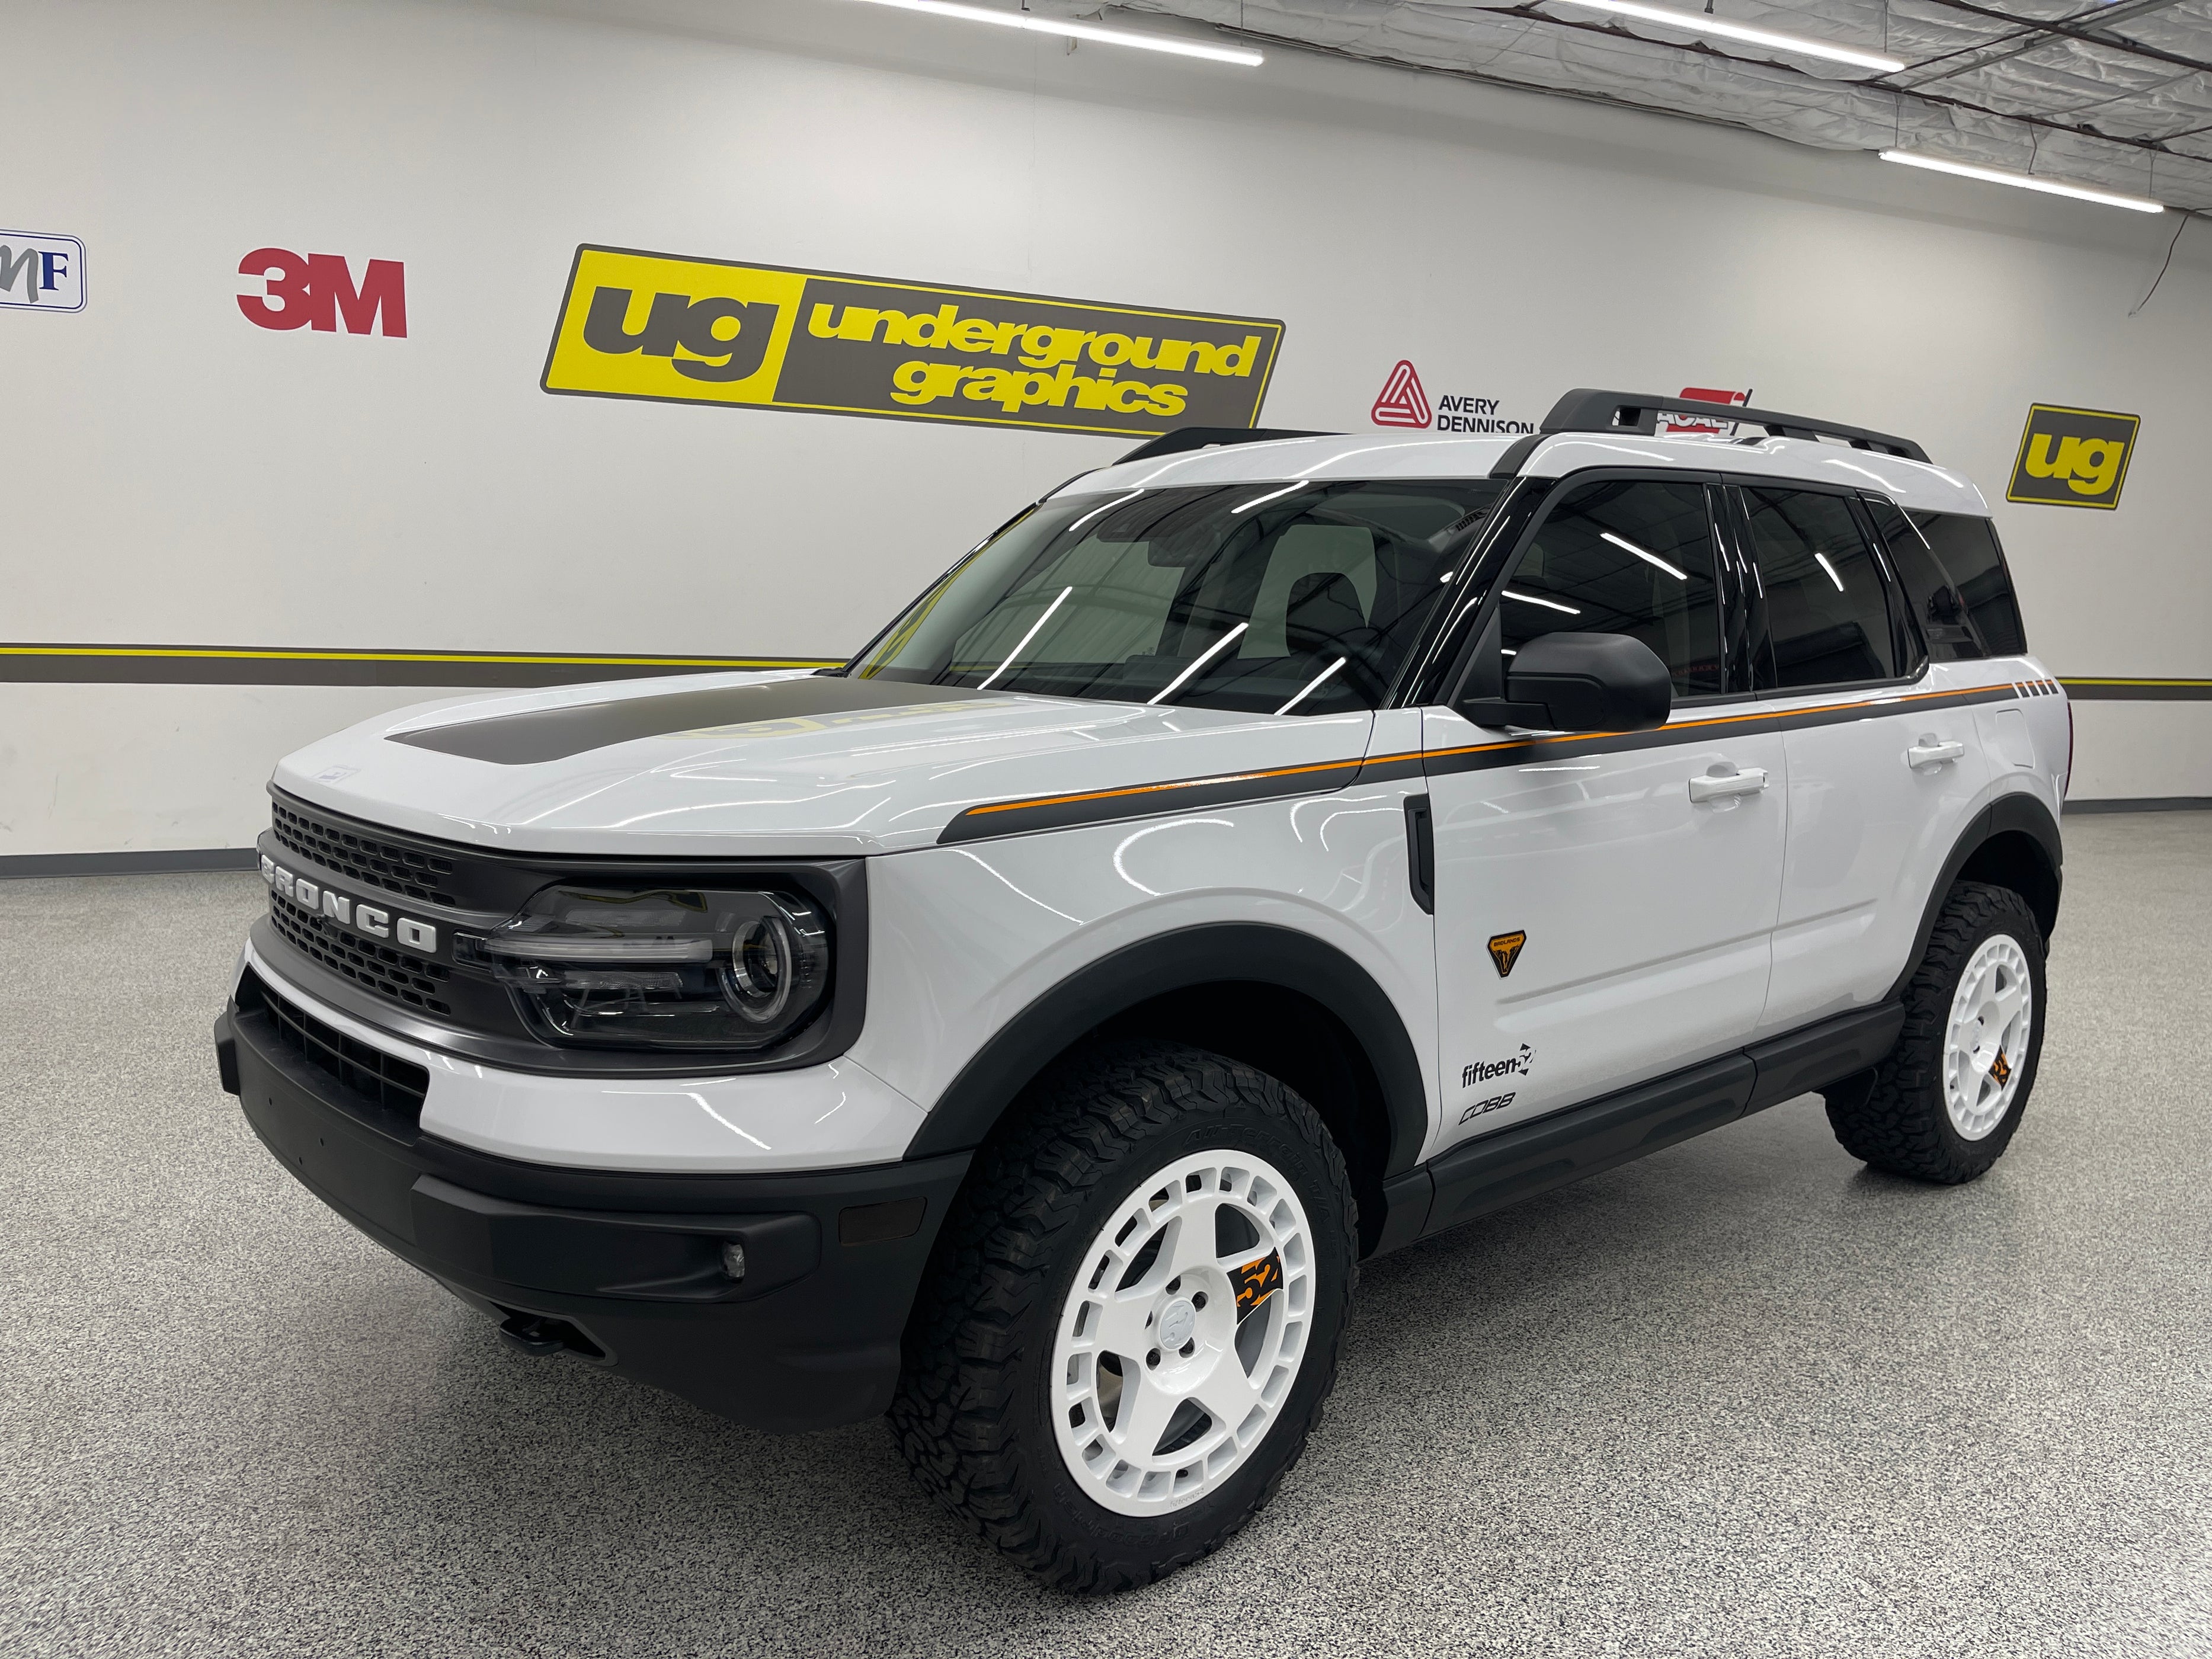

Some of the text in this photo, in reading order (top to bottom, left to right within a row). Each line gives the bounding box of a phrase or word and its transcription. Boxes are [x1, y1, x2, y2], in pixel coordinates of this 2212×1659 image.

[236, 248, 407, 338] 3M
[582, 285, 780, 383] ug
[808, 303, 1262, 377] underground
[890, 360, 1188, 416] graphics
[1438, 395, 1500, 415] AVERY
[1437, 414, 1534, 434] DENNISON
[2025, 433, 2125, 495] ug
[261, 854, 437, 953] BRONCO
[1493, 936, 1520, 947] BADLANDS
